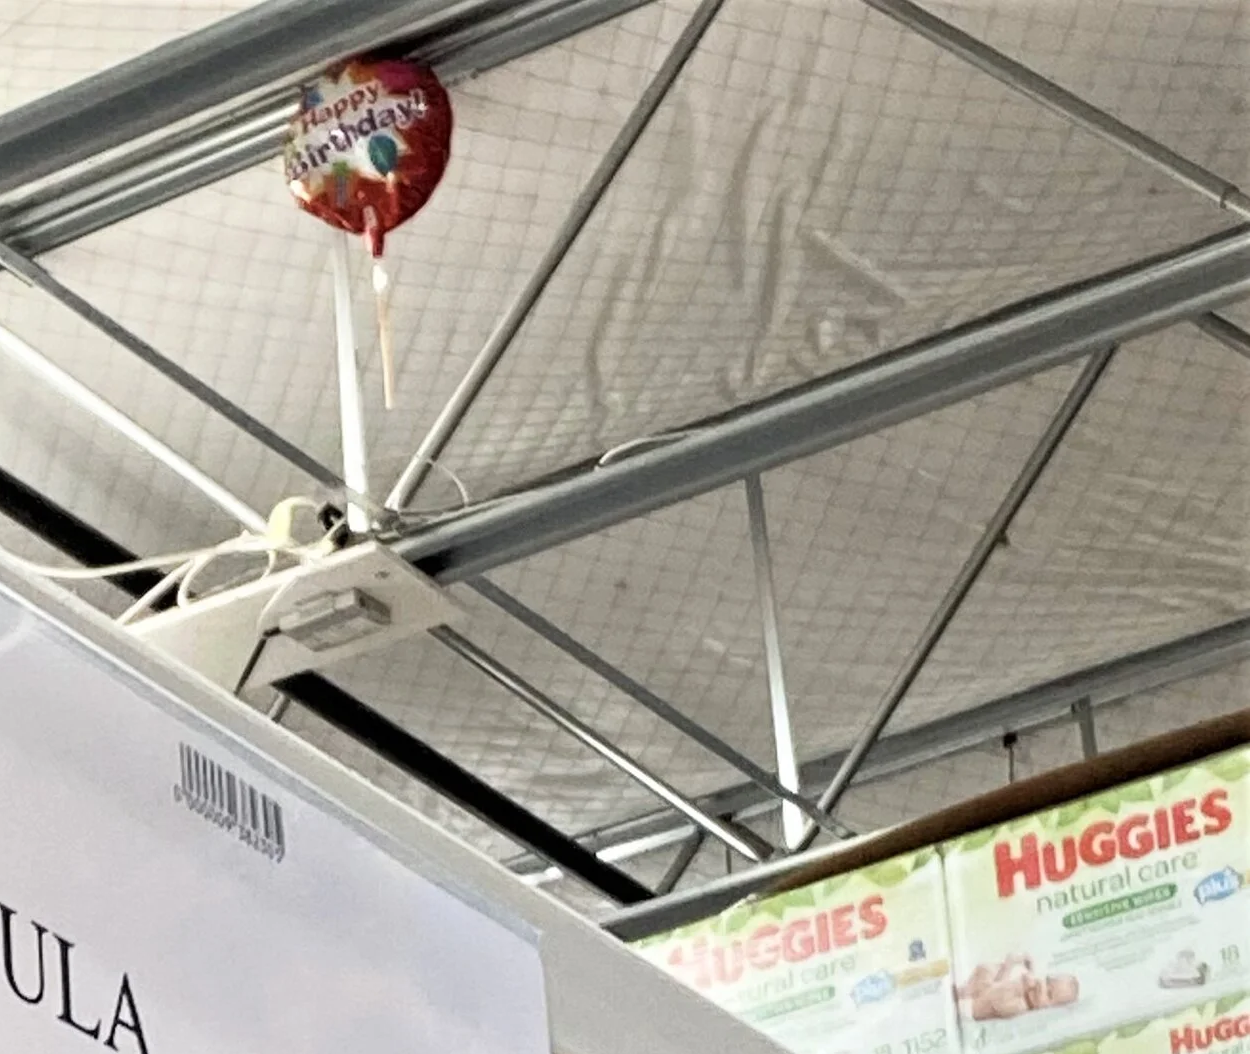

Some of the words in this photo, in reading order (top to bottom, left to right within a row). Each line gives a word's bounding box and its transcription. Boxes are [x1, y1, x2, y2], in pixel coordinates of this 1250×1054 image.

[993, 787, 1233, 900] HUGGIES
[1036, 864, 1132, 914] natural
[1138, 851, 1199, 883] care
